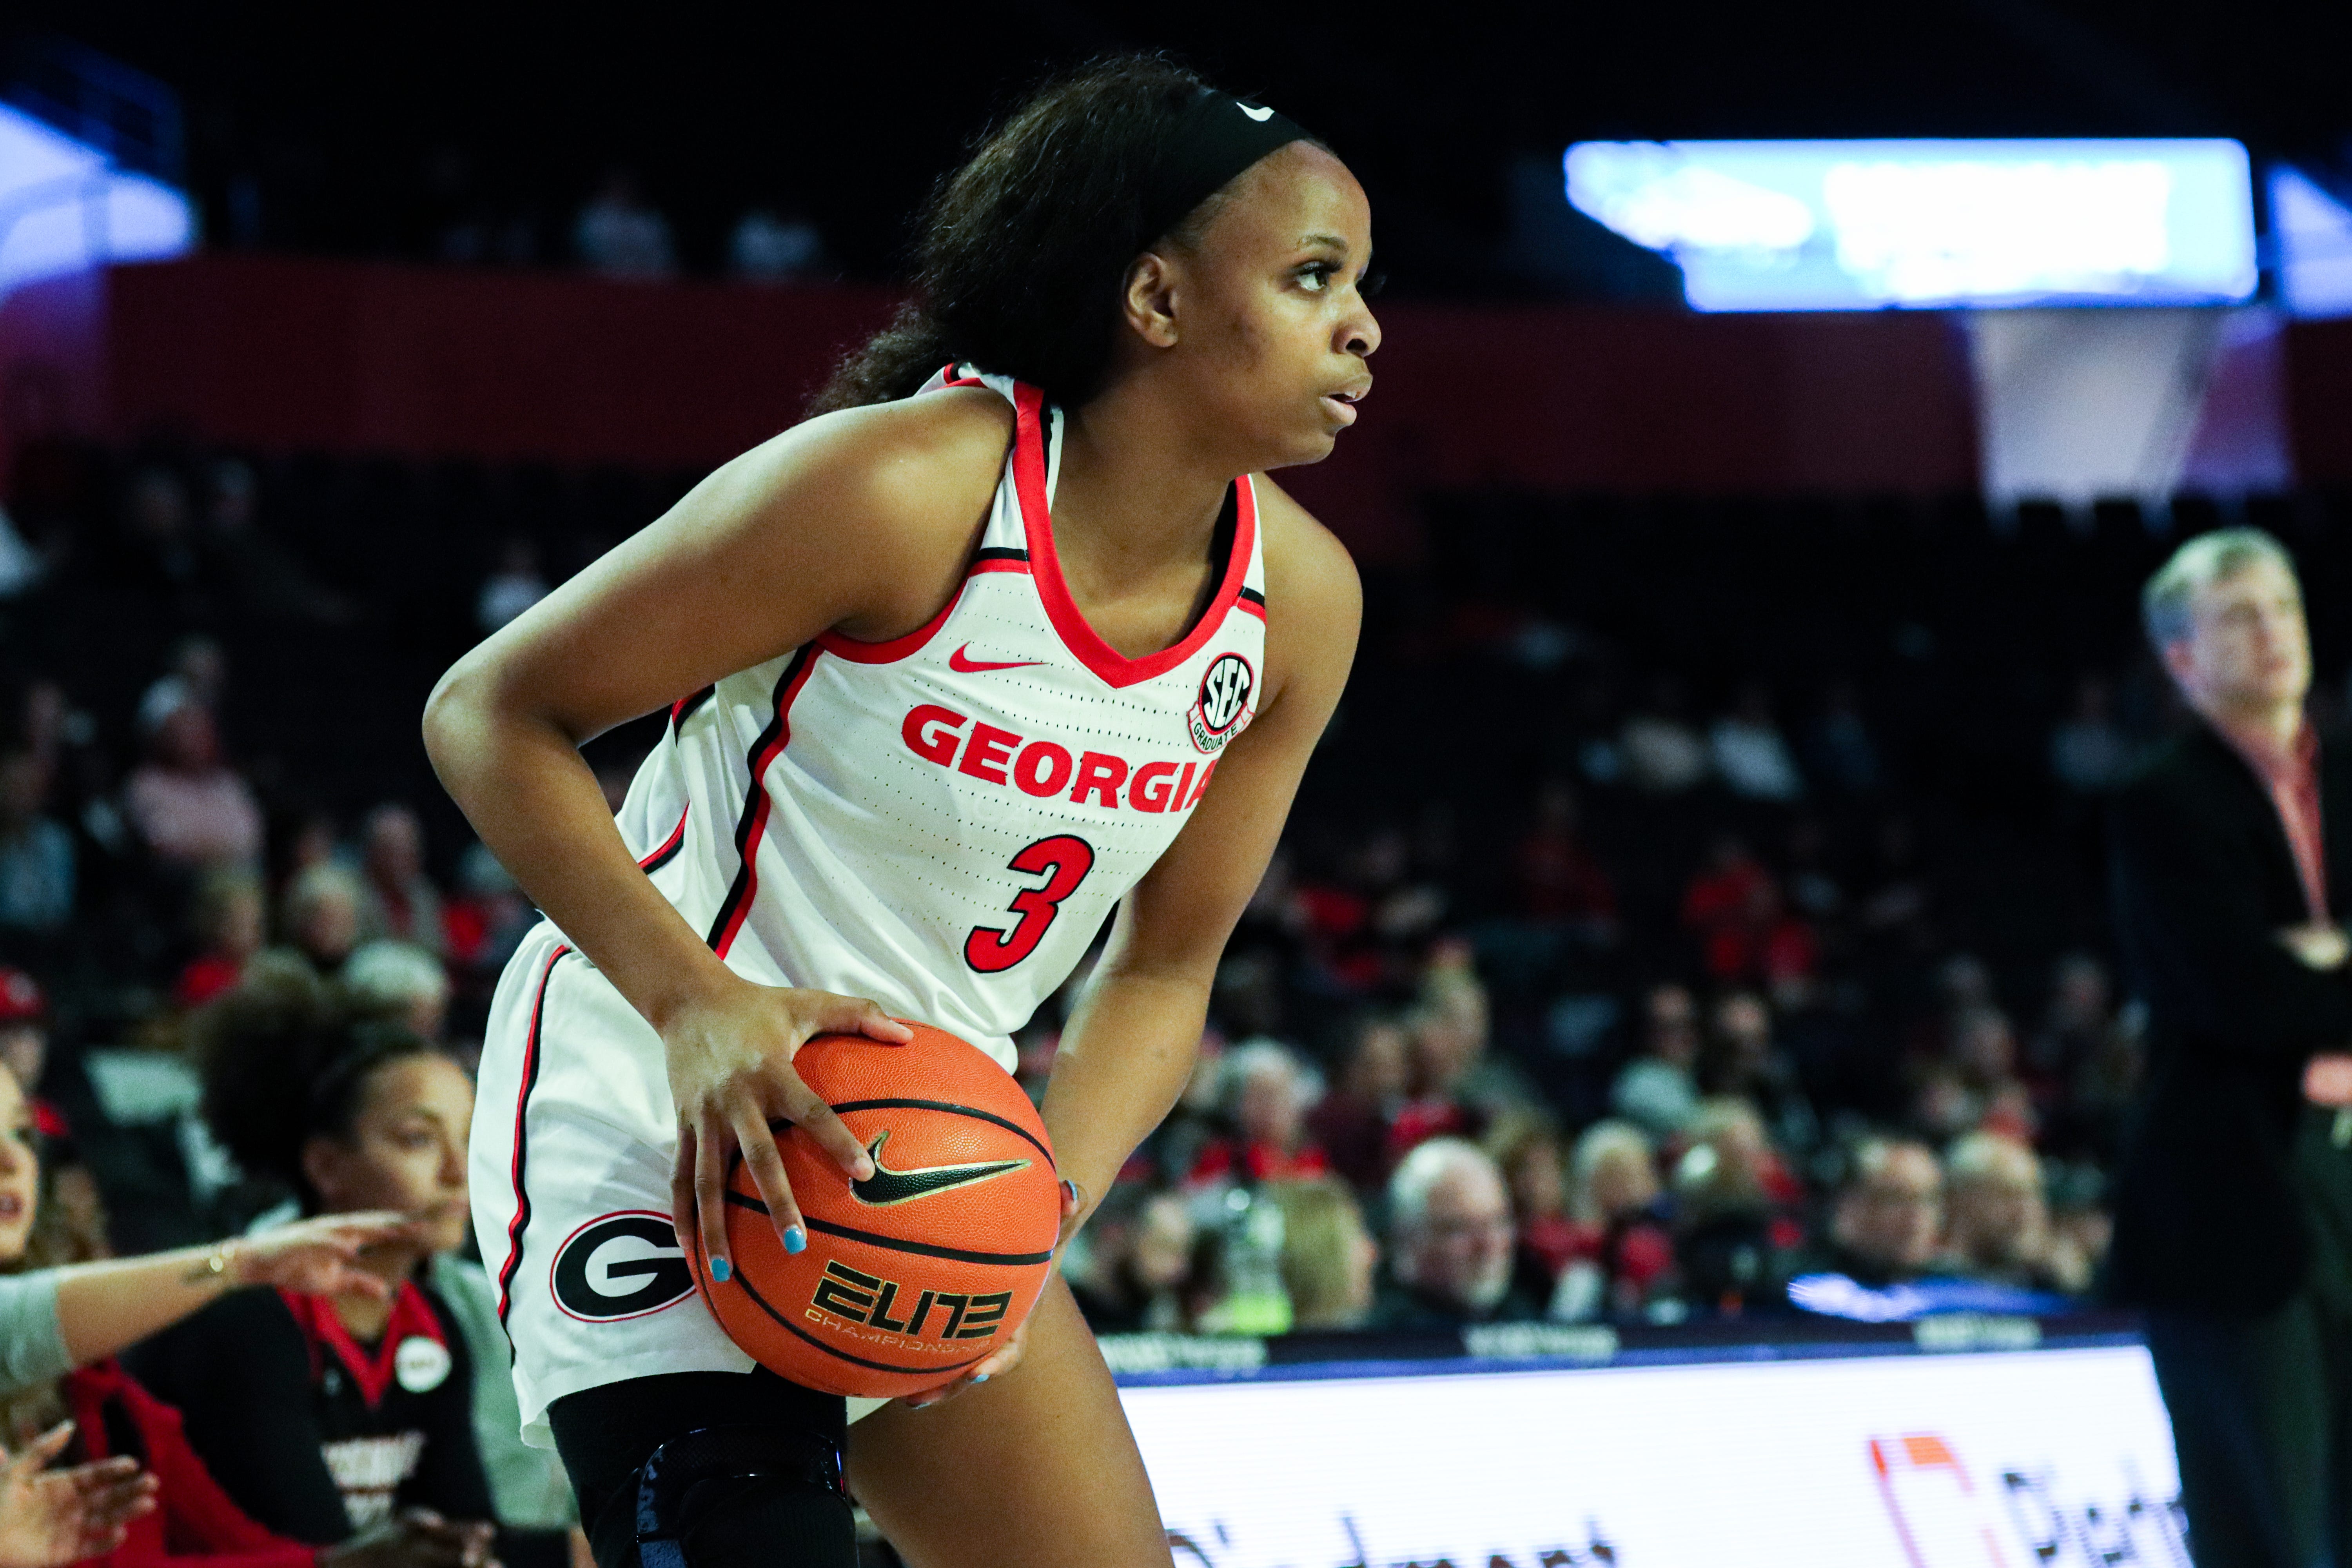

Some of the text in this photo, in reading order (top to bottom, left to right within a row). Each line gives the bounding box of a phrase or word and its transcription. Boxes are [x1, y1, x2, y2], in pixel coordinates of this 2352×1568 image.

[1194, 722, 1238, 751] GRADUATE
[1204, 658, 1250, 728] SEC
[902, 704, 1219, 813] GEORGIA
[964, 833, 1095, 973] 3
[550, 1210, 696, 1322] G
[810, 1259, 1013, 1340] ELITE
